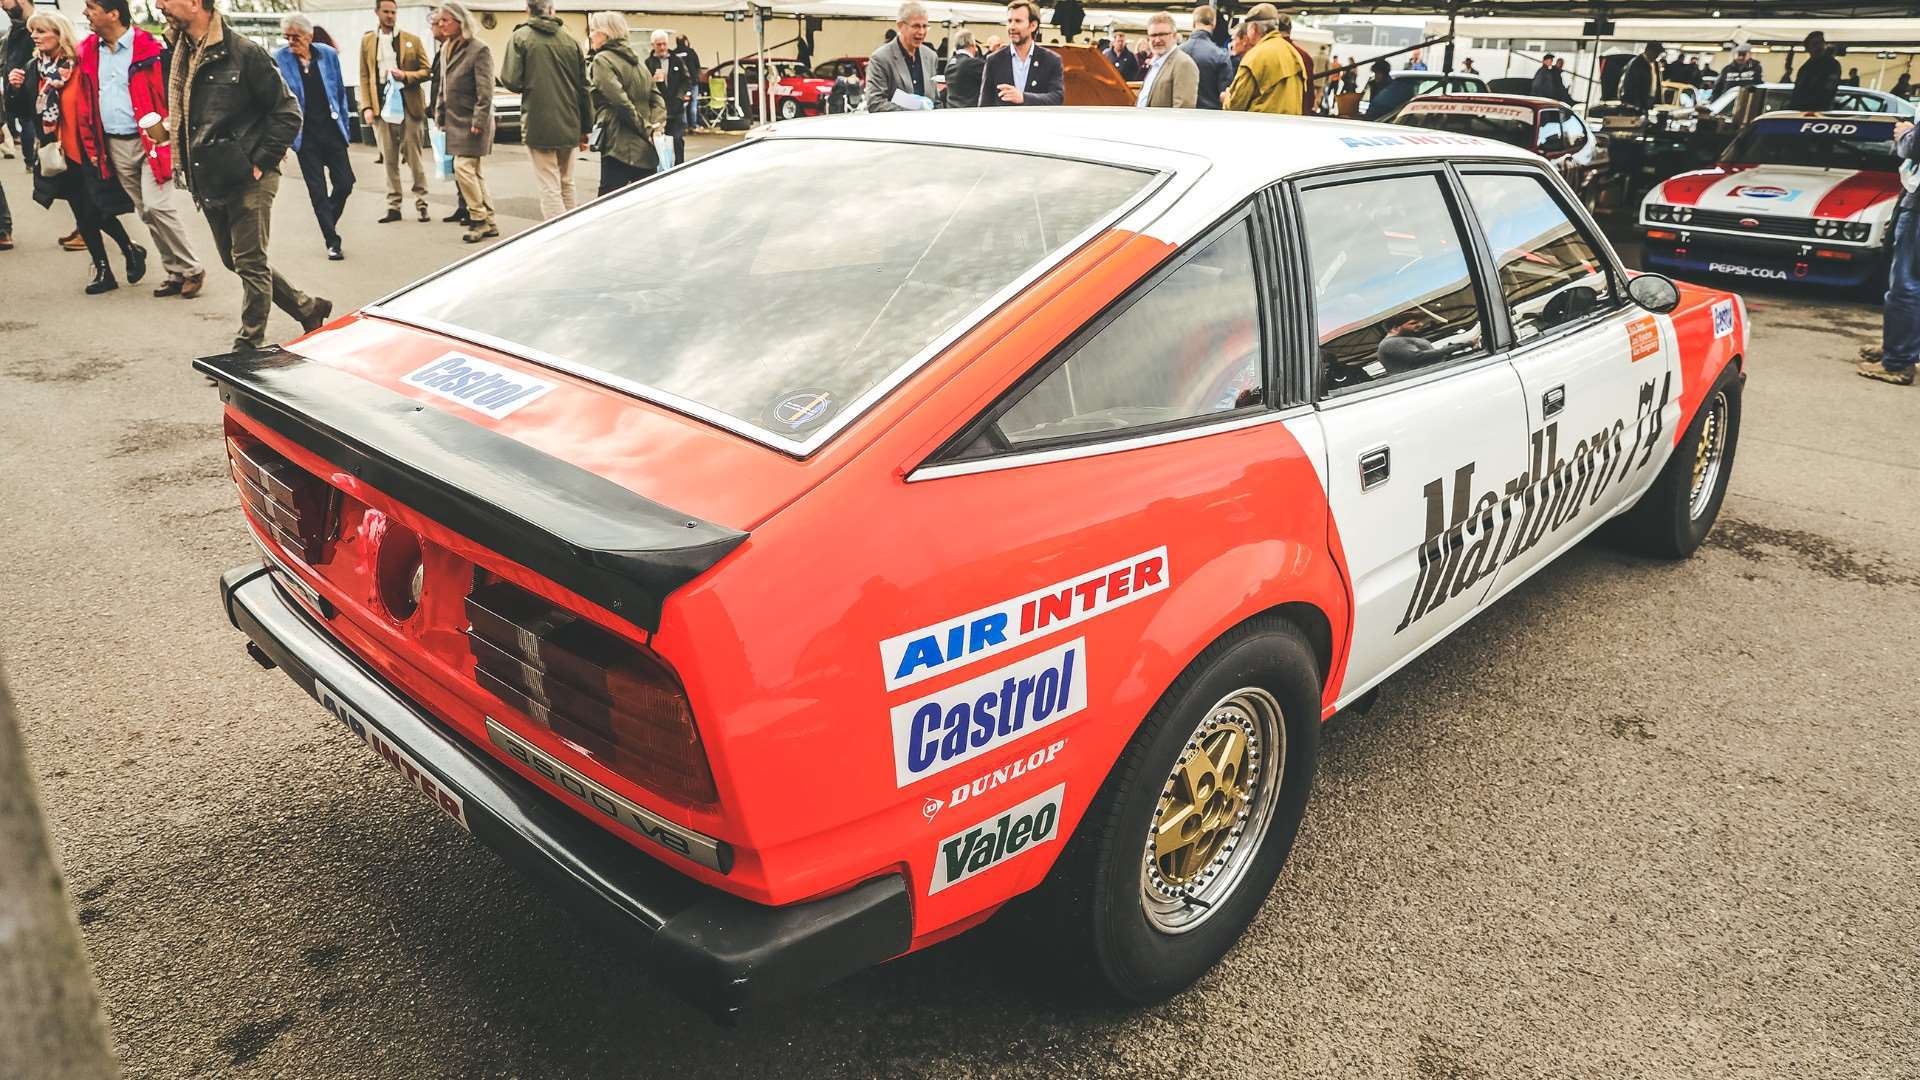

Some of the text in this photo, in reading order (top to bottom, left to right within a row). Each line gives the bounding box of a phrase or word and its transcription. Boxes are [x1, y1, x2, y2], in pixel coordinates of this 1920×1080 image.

[1341, 135, 1484, 149] AIR INTER
[1800, 123, 1857, 135] FORD
[1709, 262, 1788, 280] PEPSI-COLA
[411, 357, 544, 410] Castrol
[1394, 417, 1625, 635] Marlboro
[894, 556, 1164, 680] AIR INTER
[907, 648, 1076, 774] Castrol
[324, 693, 463, 825] AIR INTER
[506, 739, 690, 855] 3500 V8
[949, 739, 1065, 808] DUNLOP
[942, 802, 1058, 884] Valeo
